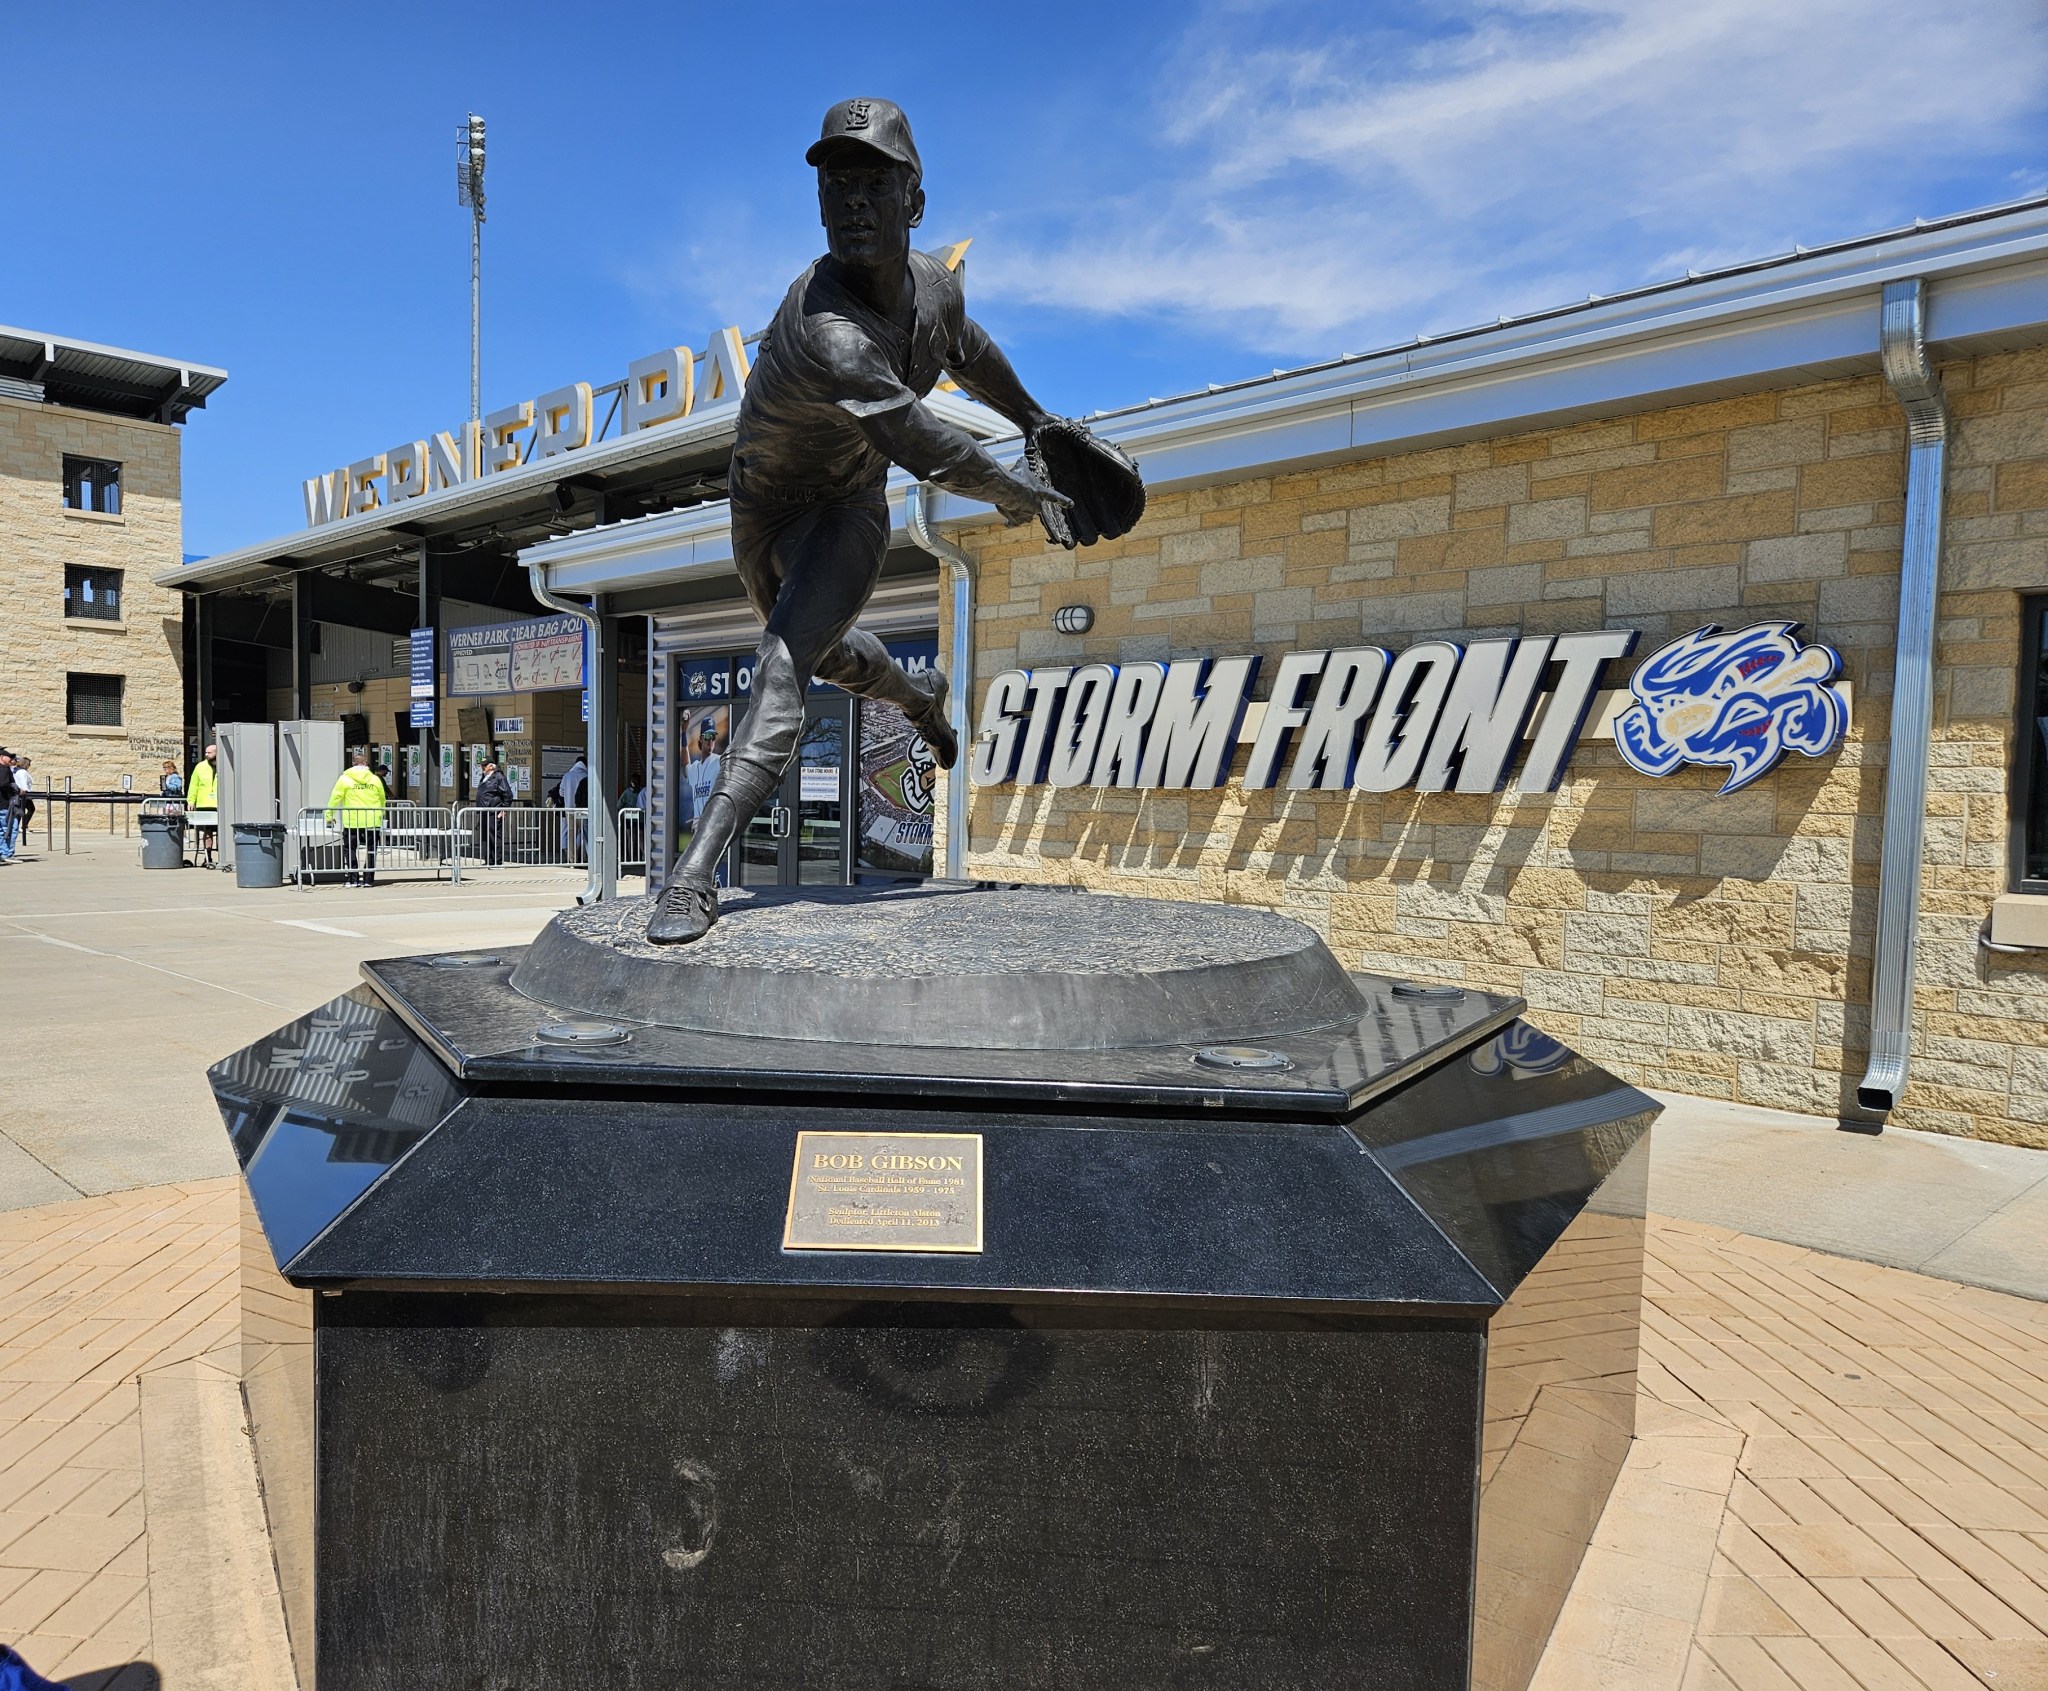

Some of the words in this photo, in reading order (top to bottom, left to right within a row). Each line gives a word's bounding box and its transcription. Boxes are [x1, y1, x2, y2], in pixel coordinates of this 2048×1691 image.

[302, 382, 594, 528] WERNER
[620, 324, 752, 436] PA
[449, 631, 484, 648] WERNER
[484, 628, 510, 644] PARK
[511, 624, 536, 642] CLEAR
[537, 620, 559, 638] BAG
[453, 649, 473, 657] APPROVED
[971, 654, 1261, 788] STORM
[1241, 629, 1641, 794] FRONT
[498, 719, 508, 732] WILL
[508, 719, 519, 732] CALL
[140, 752, 175, 760] ENTRANCE
[812, 1153, 863, 1170] BOB
[871, 1154, 964, 1171] GIBSON
[809, 1175, 847, 1184] National
[849, 1176, 885, 1185] Baseball
[887, 1176, 905, 1185] Hall
[906, 1177, 916, 1185] of
[943, 1178, 965, 1186] 1981
[817, 1184, 830, 1192] St.
[832, 1185, 857, 1193] Louis
[858, 1185, 901, 1194] Cardinals
[903, 1186, 925, 1194] 1959
[933, 1187, 955, 1195] 1975
[870, 1208, 910, 1217] Littleton
[912, 1209, 941, 1217] Alston
[829, 1217, 874, 1226] Dedicated
[875, 1218, 898, 1227] April
[917, 1219, 940, 1227] 2013
